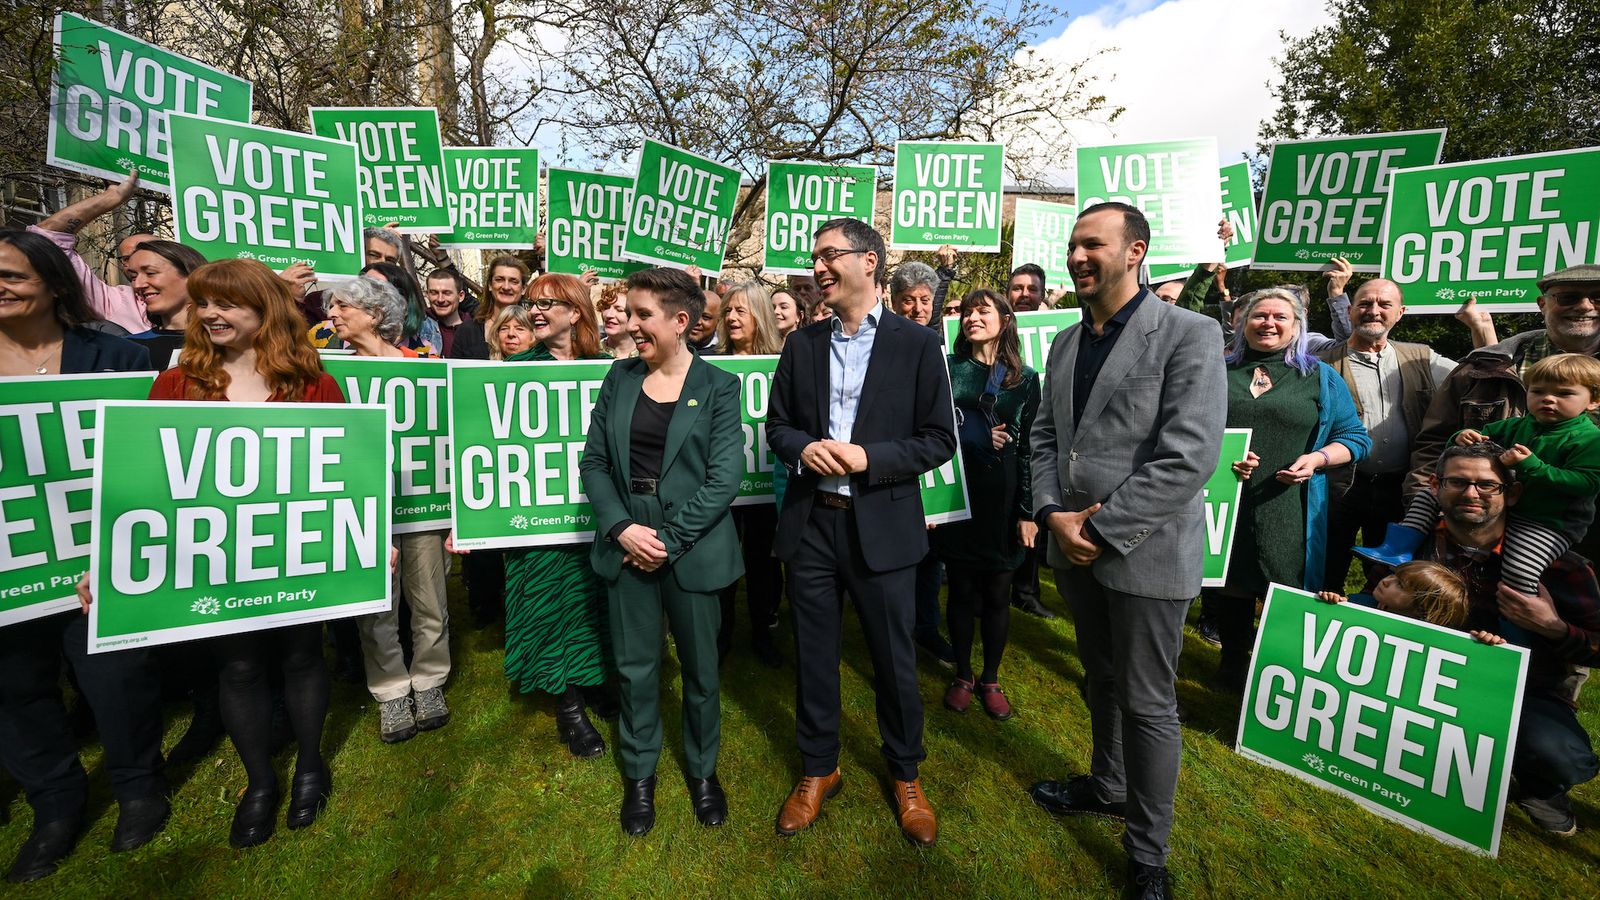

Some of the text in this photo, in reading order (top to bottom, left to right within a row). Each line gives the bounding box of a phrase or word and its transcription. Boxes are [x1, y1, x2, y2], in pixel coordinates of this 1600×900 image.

[98, 39, 222, 117] VOTE
[65, 84, 169, 162] GRE
[205, 134, 330, 198] VOTE
[360, 165, 444, 209] REEN
[454, 158, 522, 190] VOTE
[658, 156, 725, 212] VOTE
[915, 153, 985, 189] VOTE
[1296, 148, 1407, 196] VOTE
[786, 173, 857, 213] VOTE
[898, 190, 997, 229] GREEN
[1424, 168, 1566, 228] VOTE
[183, 185, 355, 254] GREEN
[377, 214, 417, 223] Green Party
[475, 232, 494, 240] Green
[551, 217, 637, 263] GREE
[632, 194, 728, 256] GREEN
[953, 234, 970, 242] Party
[1031, 210, 1073, 240] VOT
[1263, 197, 1388, 245] GREE
[258, 254, 288, 264] Green
[665, 249, 682, 257] Green
[1018, 237, 1070, 273] GRE
[1340, 251, 1364, 261] Party
[1390, 220, 1591, 284] GREEN
[1457, 288, 1527, 298] Green Party
[0, 400, 97, 477] TE
[159, 426, 345, 500] VOTE
[461, 441, 591, 511] GREE
[395, 503, 451, 516] Green Part
[530, 514, 591, 527] Green Party
[110, 496, 377, 595] GREEN
[0, 580, 45, 599] reen
[224, 589, 317, 609] Green Party
[96, 636, 148, 649] greenparty.org.uk
[1302, 611, 1468, 718] VOTE
[1254, 664, 1495, 813] GREEN
[1328, 764, 1412, 808] Green Party
